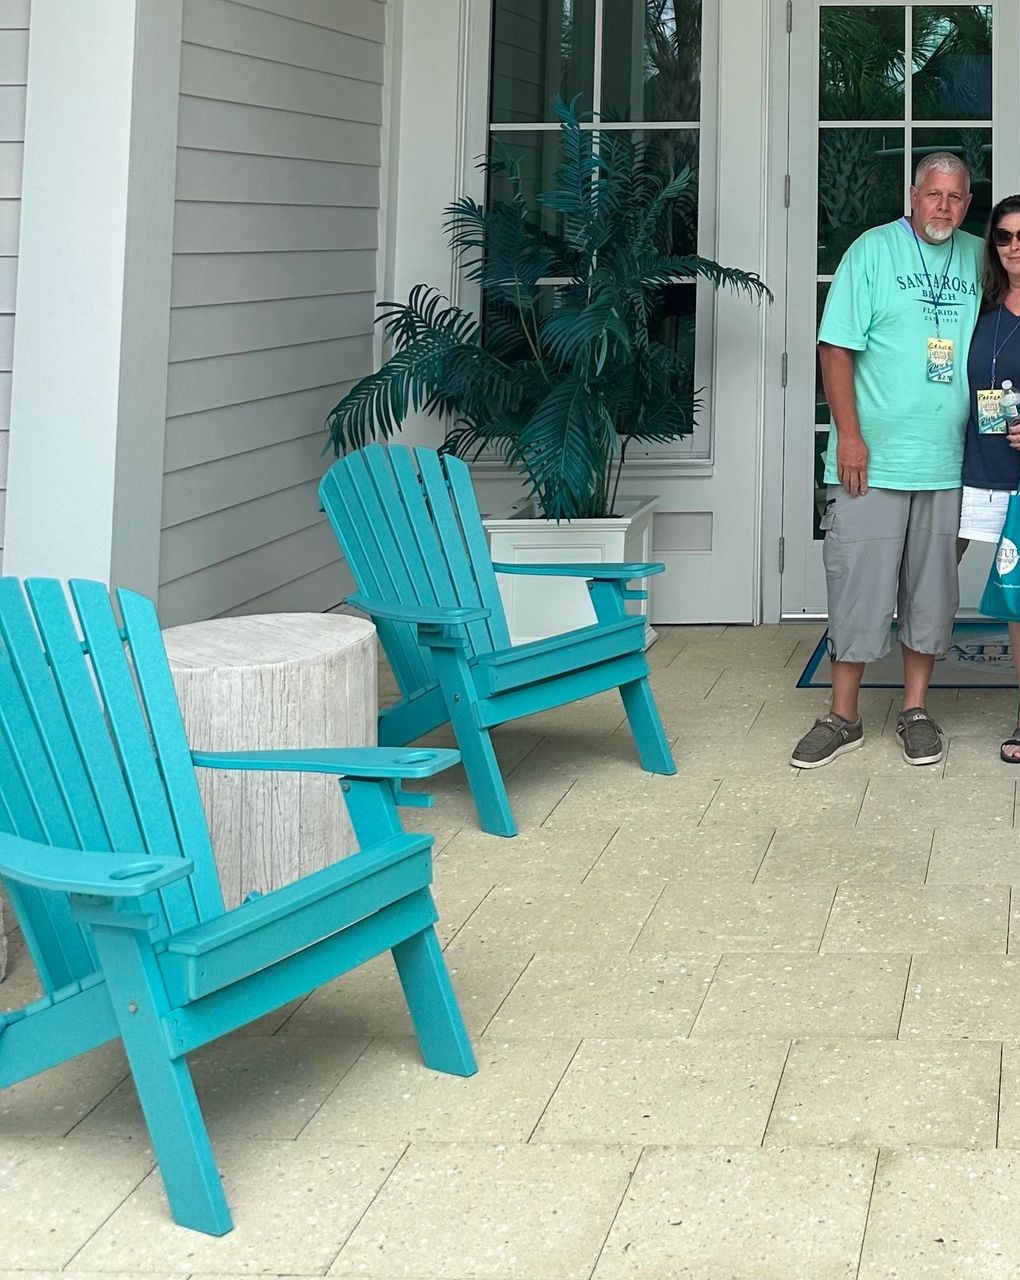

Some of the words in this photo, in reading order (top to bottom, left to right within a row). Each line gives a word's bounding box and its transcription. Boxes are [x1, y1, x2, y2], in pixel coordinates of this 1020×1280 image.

[896, 272, 940, 290] SANTA
[942, 275, 977, 297] ROSA
[922, 289, 957, 301] BEACH
[922, 307, 959, 317] FLORIDA
